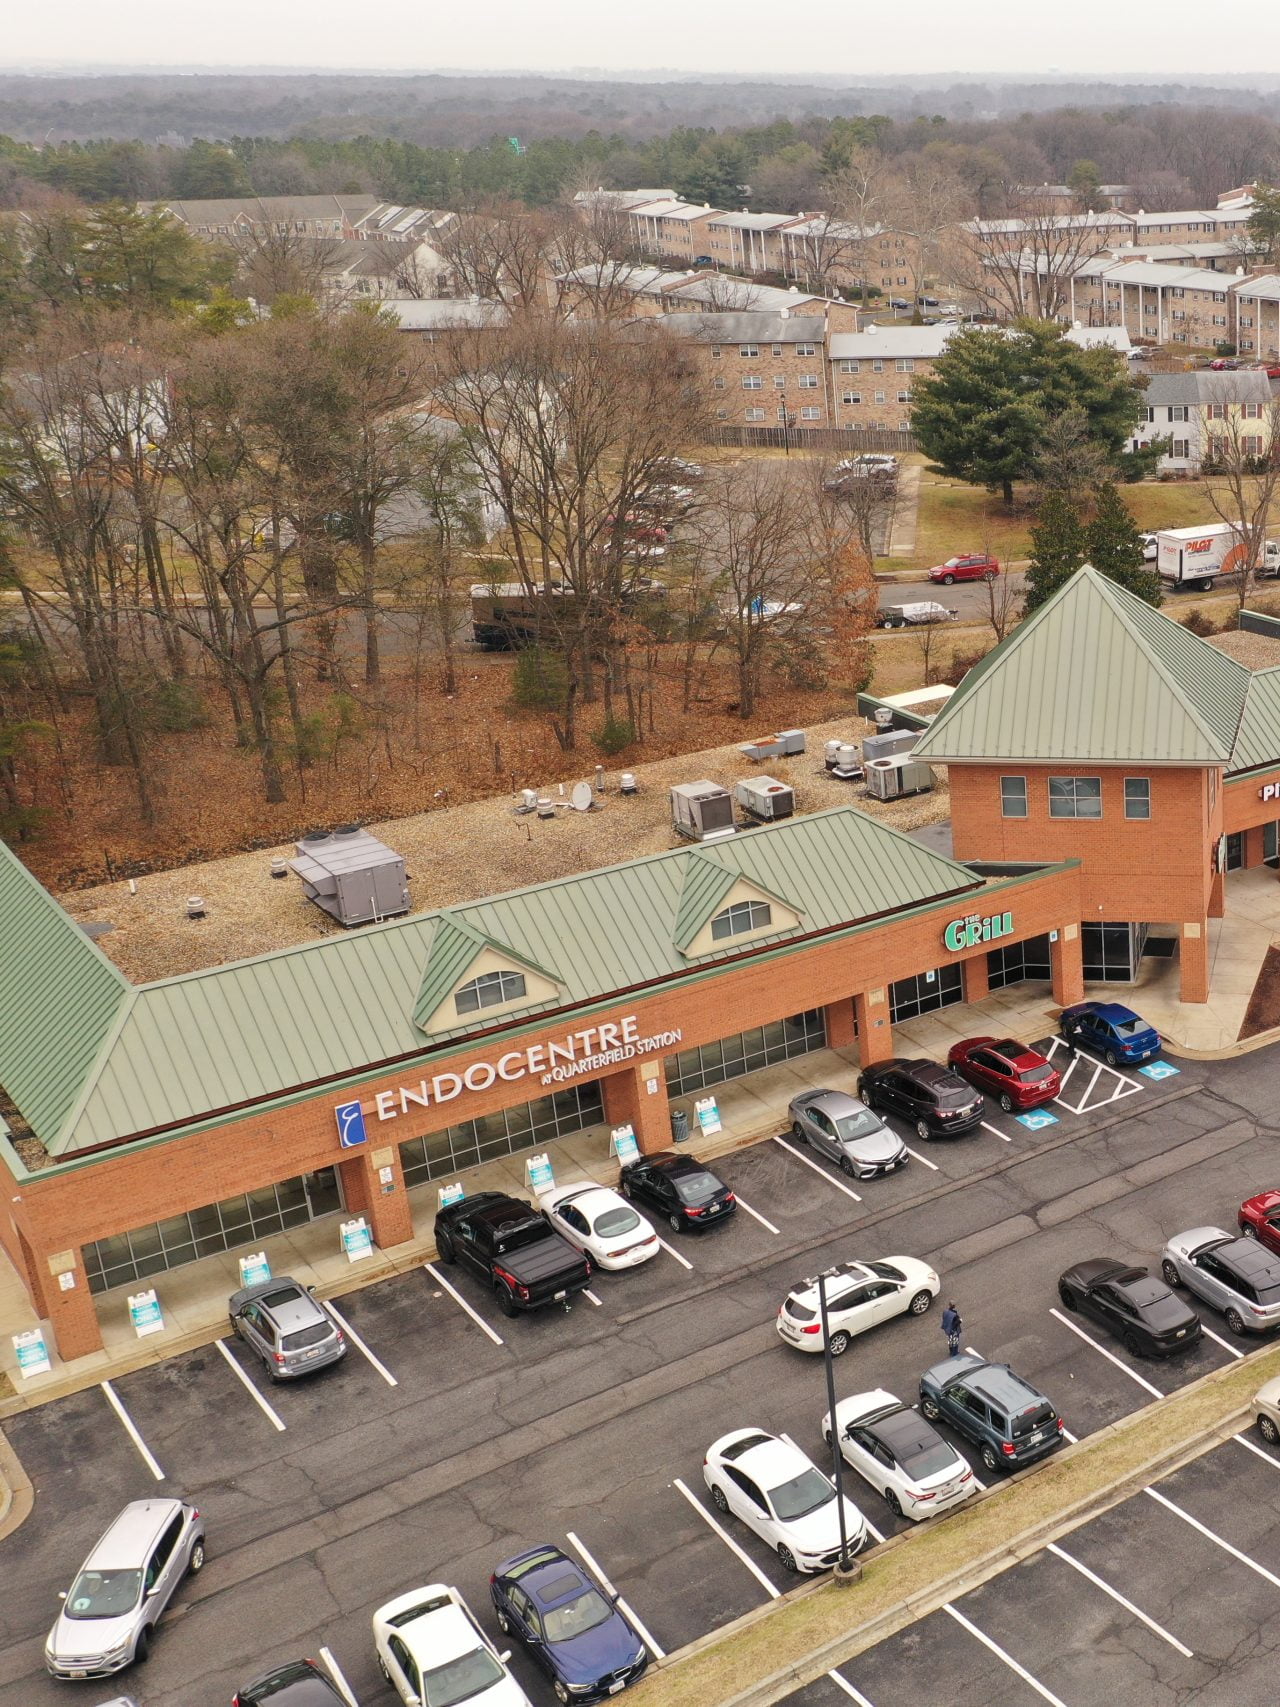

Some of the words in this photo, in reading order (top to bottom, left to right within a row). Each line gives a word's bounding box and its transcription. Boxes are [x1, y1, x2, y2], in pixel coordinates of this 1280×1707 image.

[375, 1015, 640, 1121] ENDOCENTRE
[541, 1073, 553, 1086] AT
[552, 1044, 635, 1082] QUARTERFIELD
[636, 1028, 682, 1055] STATION
